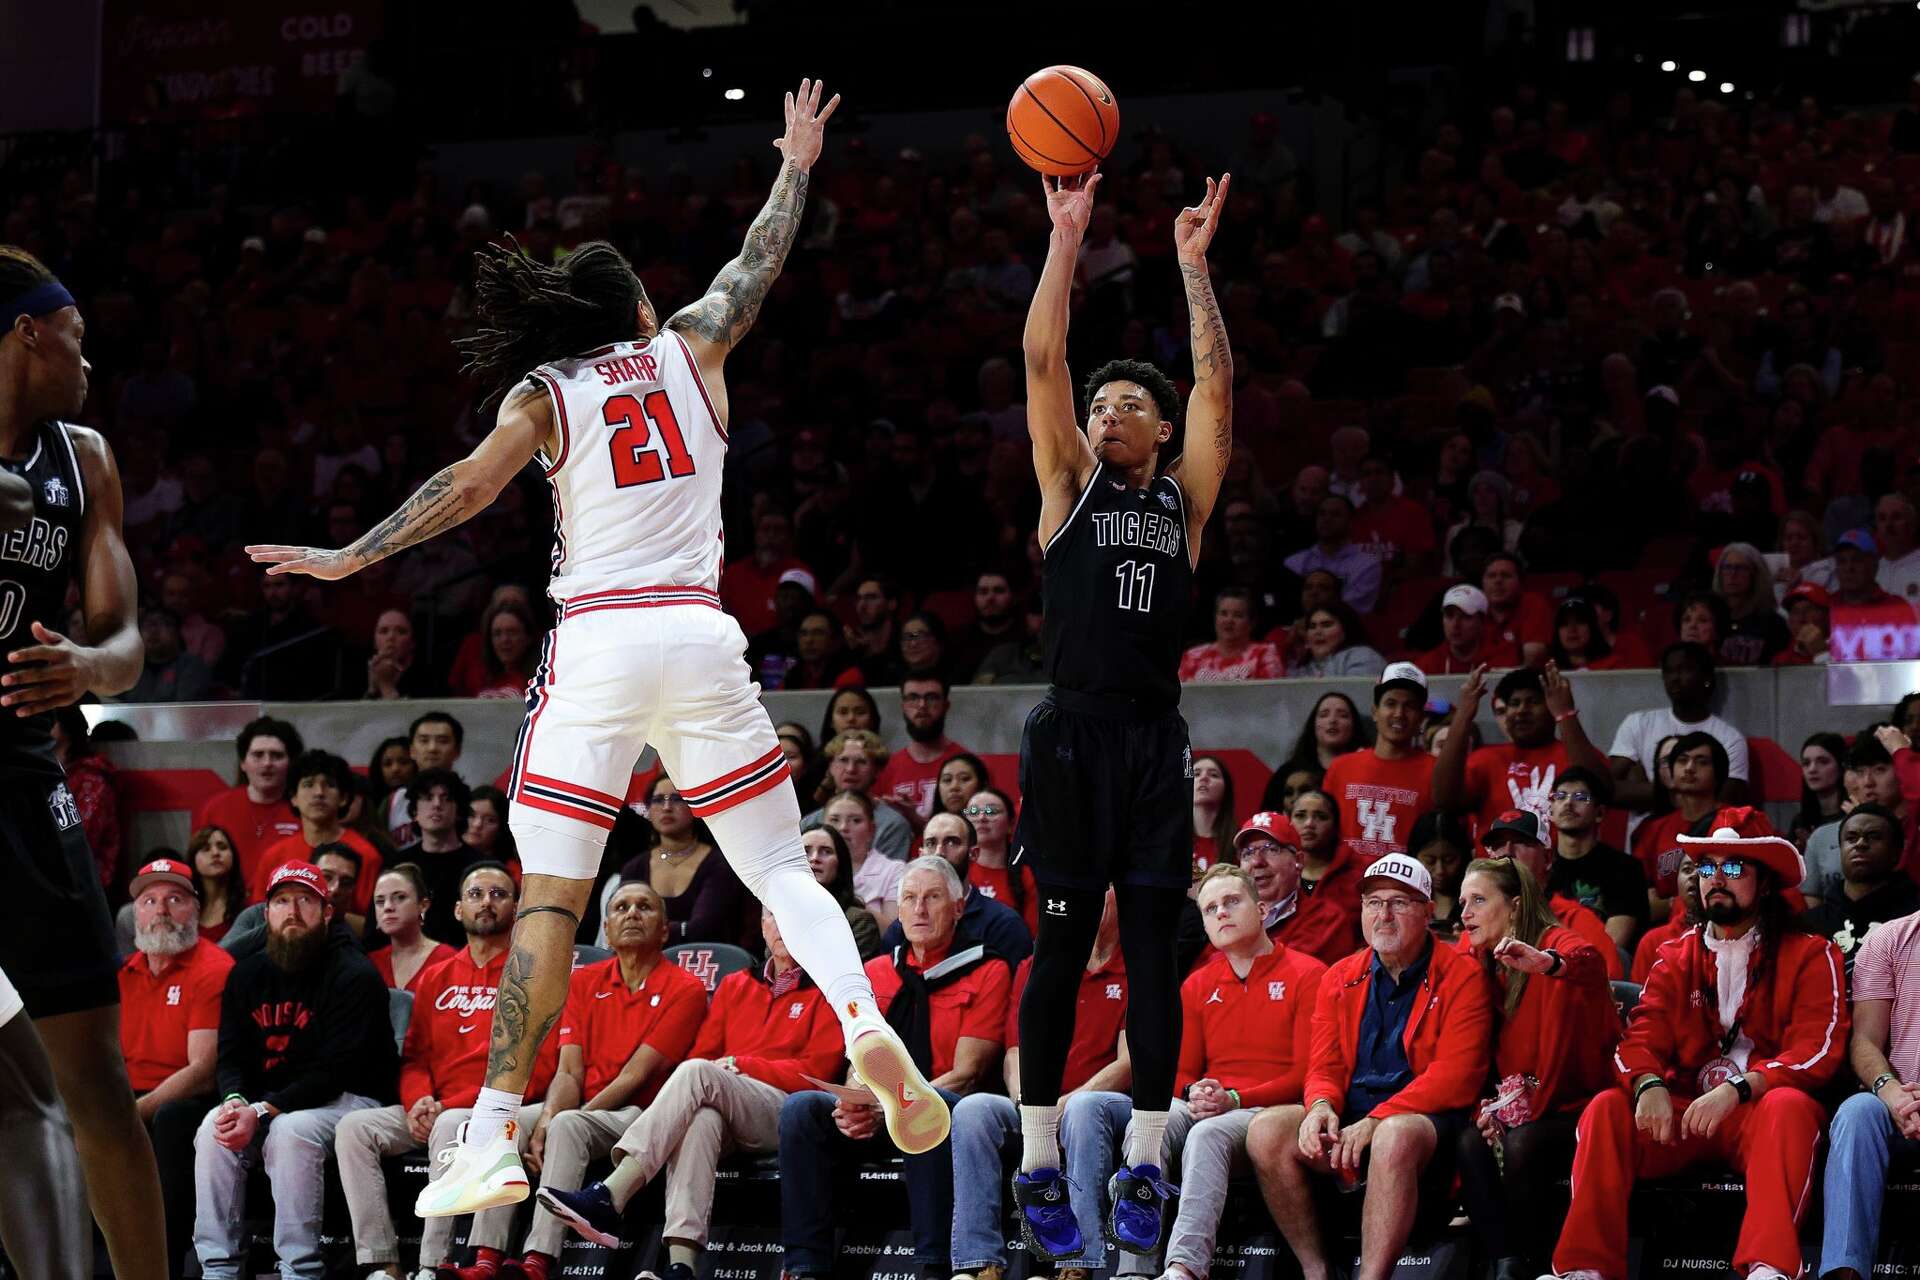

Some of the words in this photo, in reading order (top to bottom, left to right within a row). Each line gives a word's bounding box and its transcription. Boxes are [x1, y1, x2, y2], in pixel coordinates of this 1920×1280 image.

[280, 13, 353, 41] COLD
[594, 353, 658, 387] SHARP
[601, 389, 697, 490] 21
[0, 516, 69, 572] ERS
[1092, 511, 1181, 558] TIGERS
[1115, 559, 1156, 613] 11
[1356, 799, 1398, 844] UH
[736, 1242, 763, 1253] Jack
[883, 1244, 892, 1255] &
[894, 1245, 916, 1256] Jac
[562, 1265, 605, 1276] FL4:1:14
[713, 1268, 758, 1280] FL4:1:15
[1662, 1258, 1679, 1269] DJ
